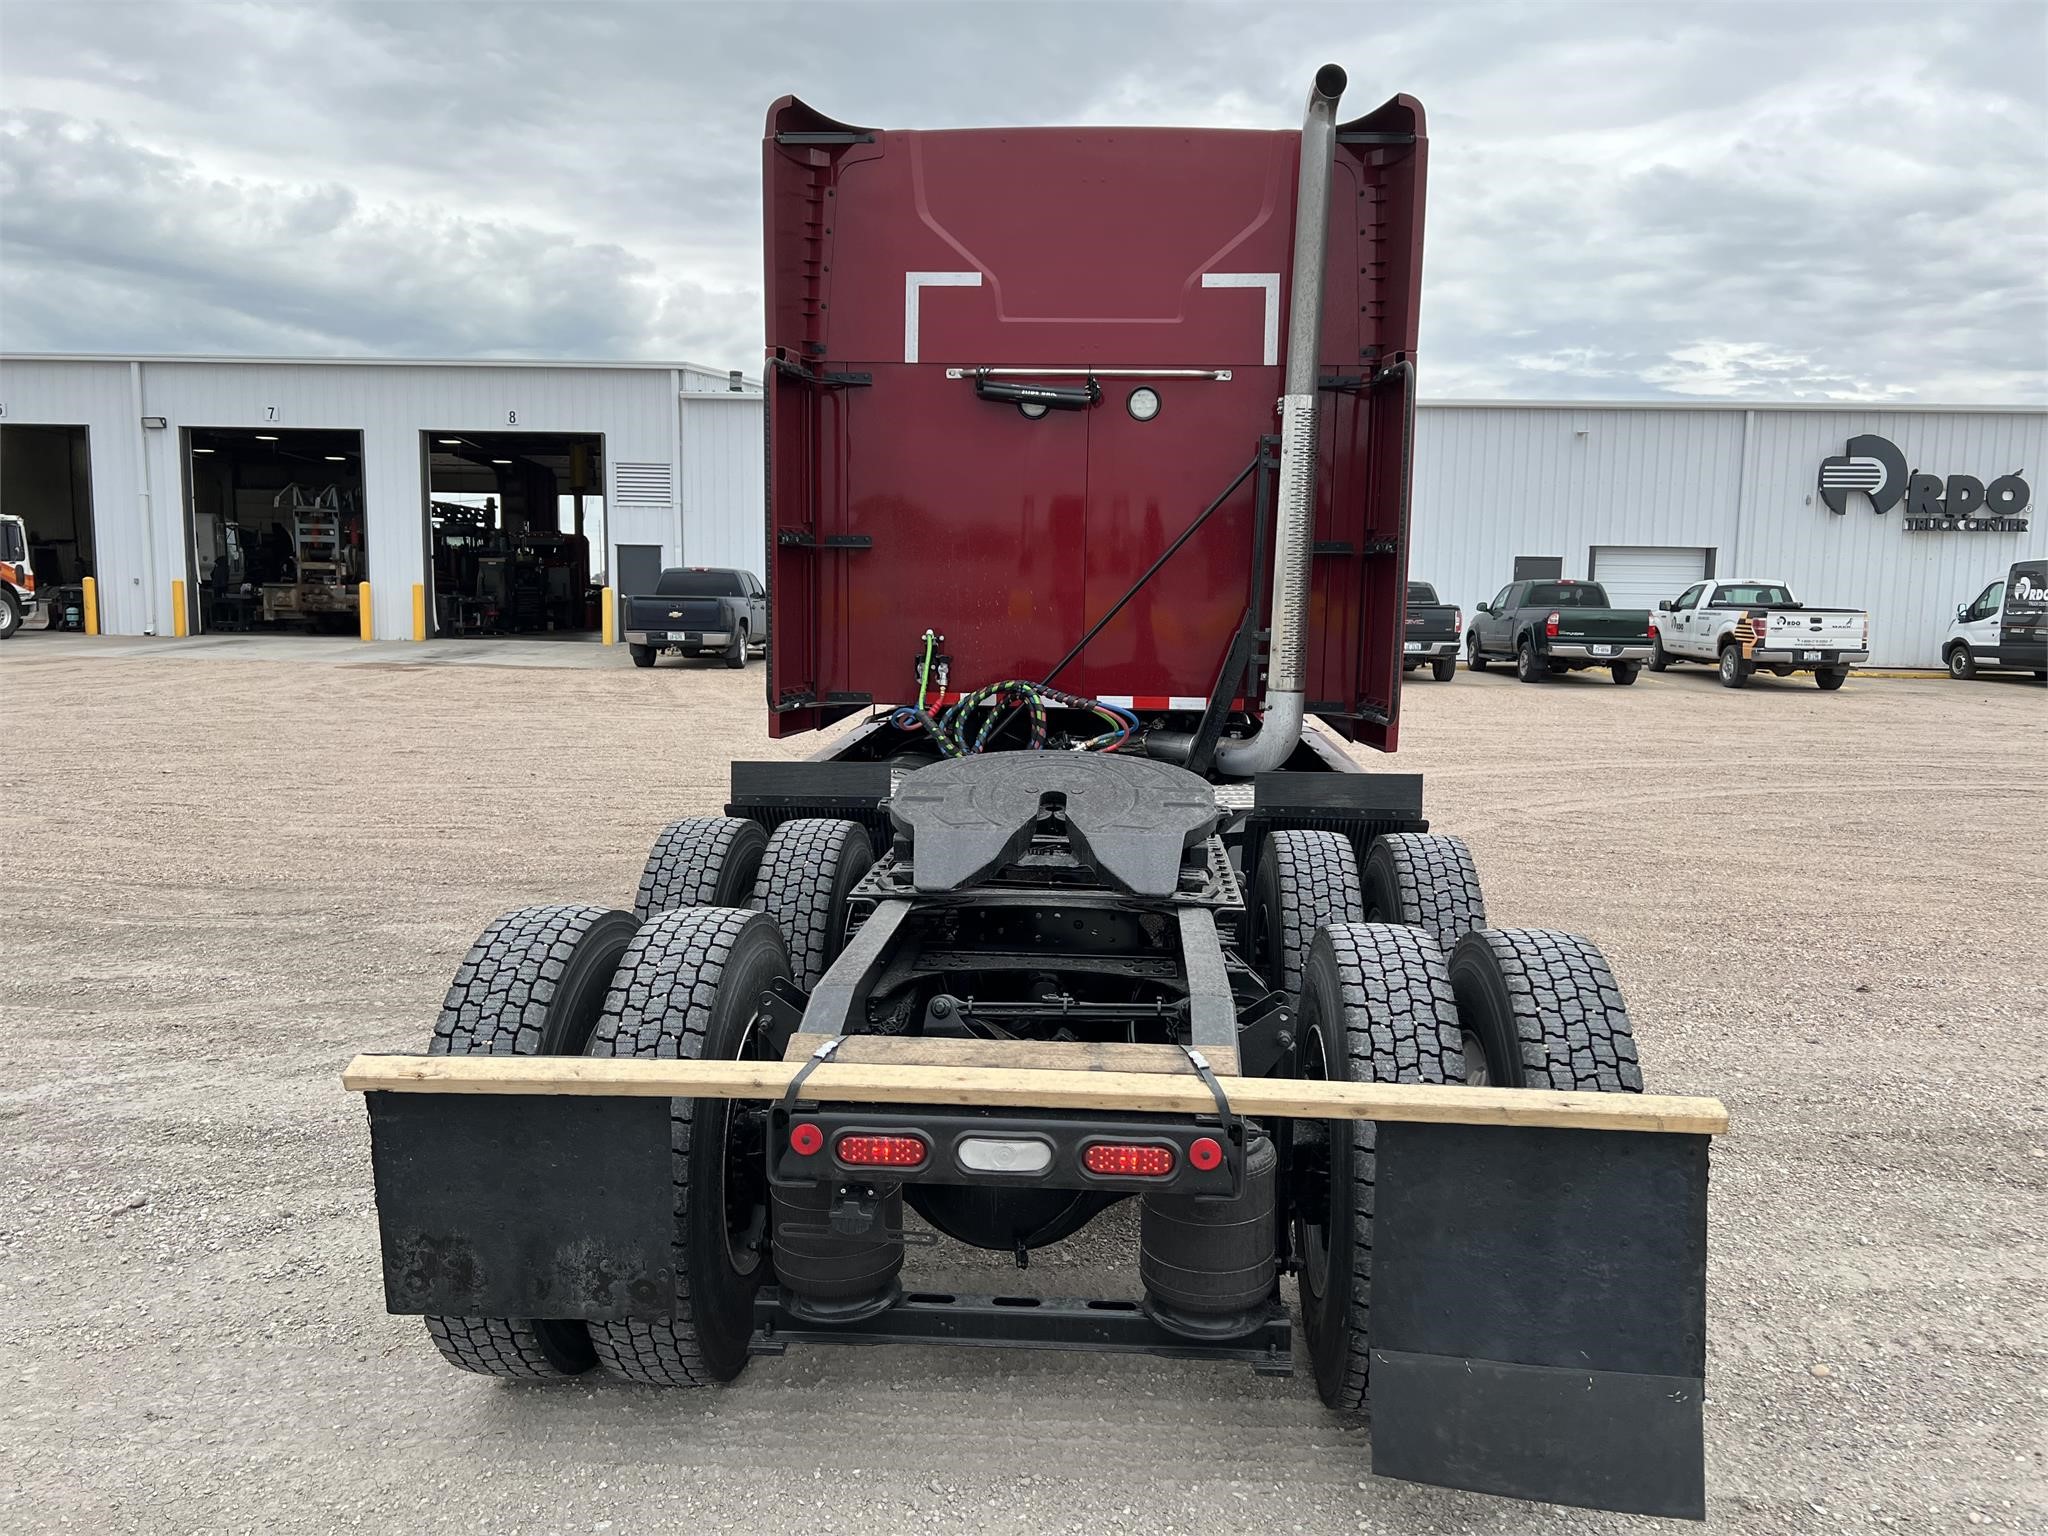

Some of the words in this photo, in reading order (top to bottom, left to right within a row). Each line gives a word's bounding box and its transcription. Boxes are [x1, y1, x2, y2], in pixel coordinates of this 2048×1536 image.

[267, 407, 275, 420] 7
[508, 410, 516, 424] 8
[1906, 473, 2031, 515] RDO
[1905, 518, 1960, 531] TRUCK
[1964, 518, 2029, 532] CENTER
